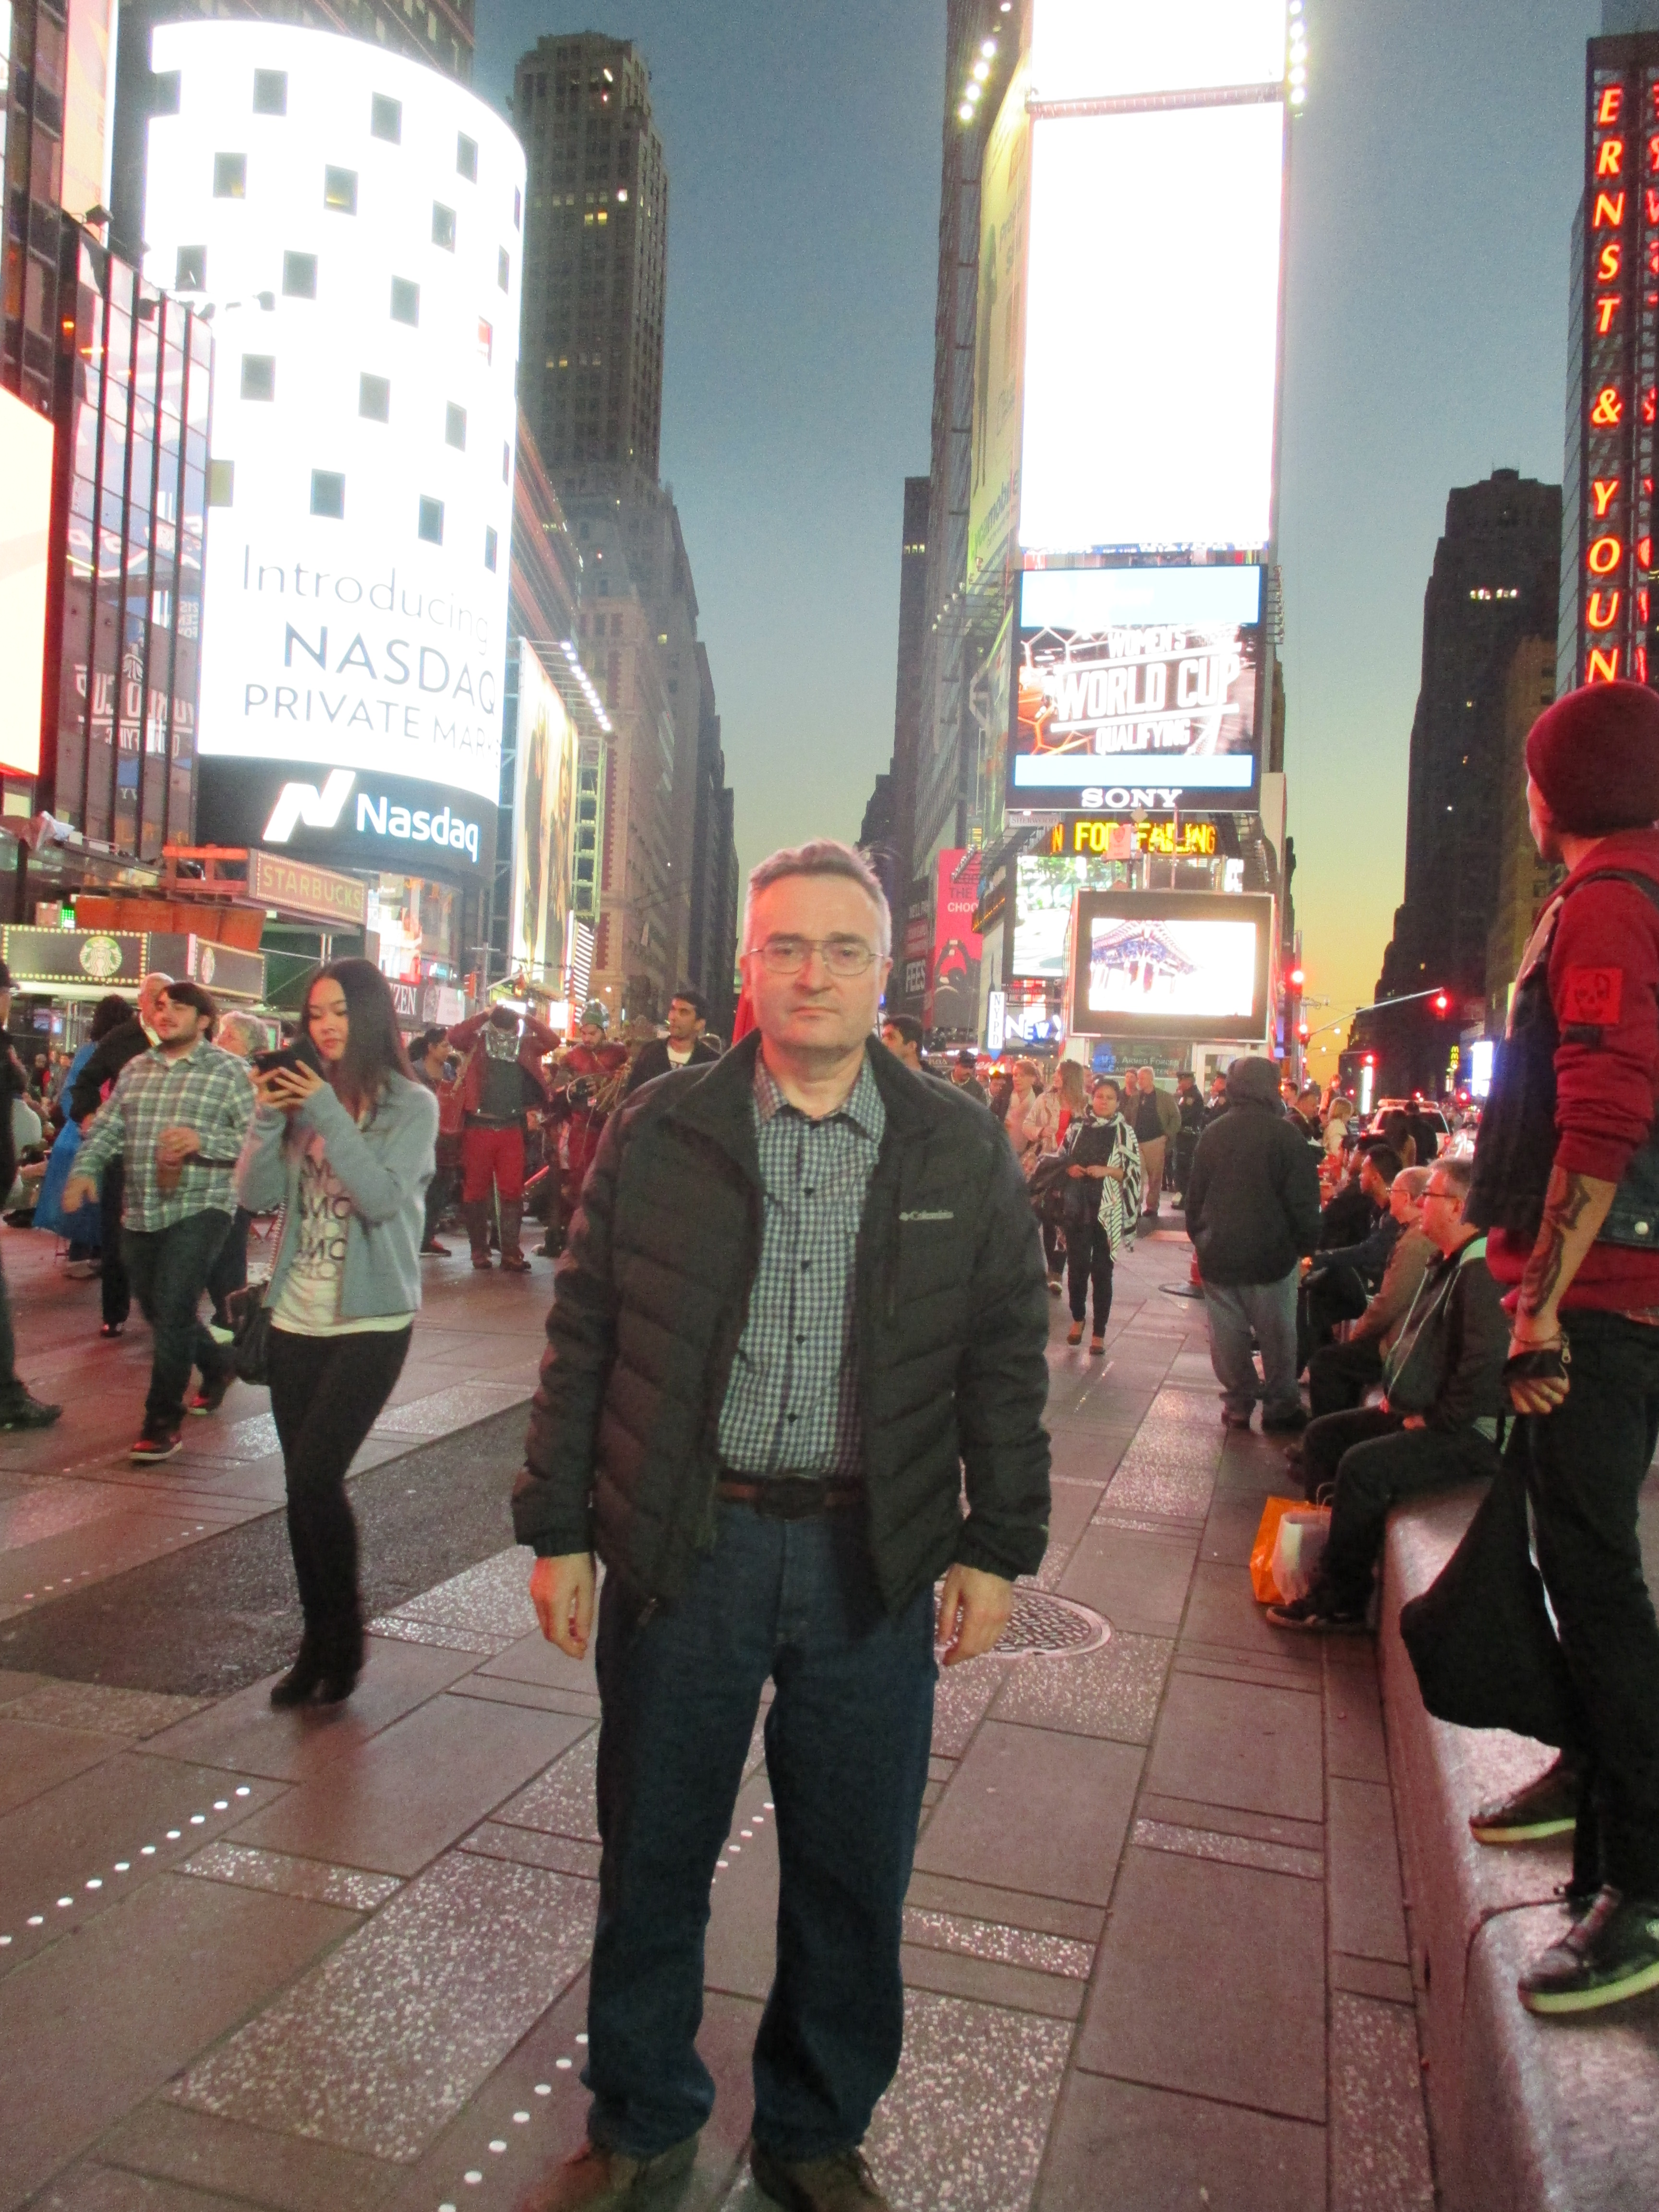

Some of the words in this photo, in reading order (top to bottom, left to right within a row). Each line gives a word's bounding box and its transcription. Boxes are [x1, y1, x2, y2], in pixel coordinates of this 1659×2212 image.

[1593, 87, 1624, 333] ERNST
[1591, 388, 1623, 424] &
[243, 544, 489, 655] Introducing
[1587, 480, 1622, 683] YOUN
[284, 621, 495, 716] NASDAQ
[1108, 625, 1188, 659] WOMEN'S
[244, 684, 421, 740] PRIVATE
[1056, 662, 1167, 721] WORLD
[1177, 652, 1242, 709] CUP
[1094, 718, 1191, 755] QUALIFYING
[1082, 789, 1183, 808] SONY
[356, 793, 479, 863] Nasdaq
[263, 865, 361, 910] STARBUCKS
[948, 887, 973, 899] THE
[992, 994, 1001, 1046] NYPD
